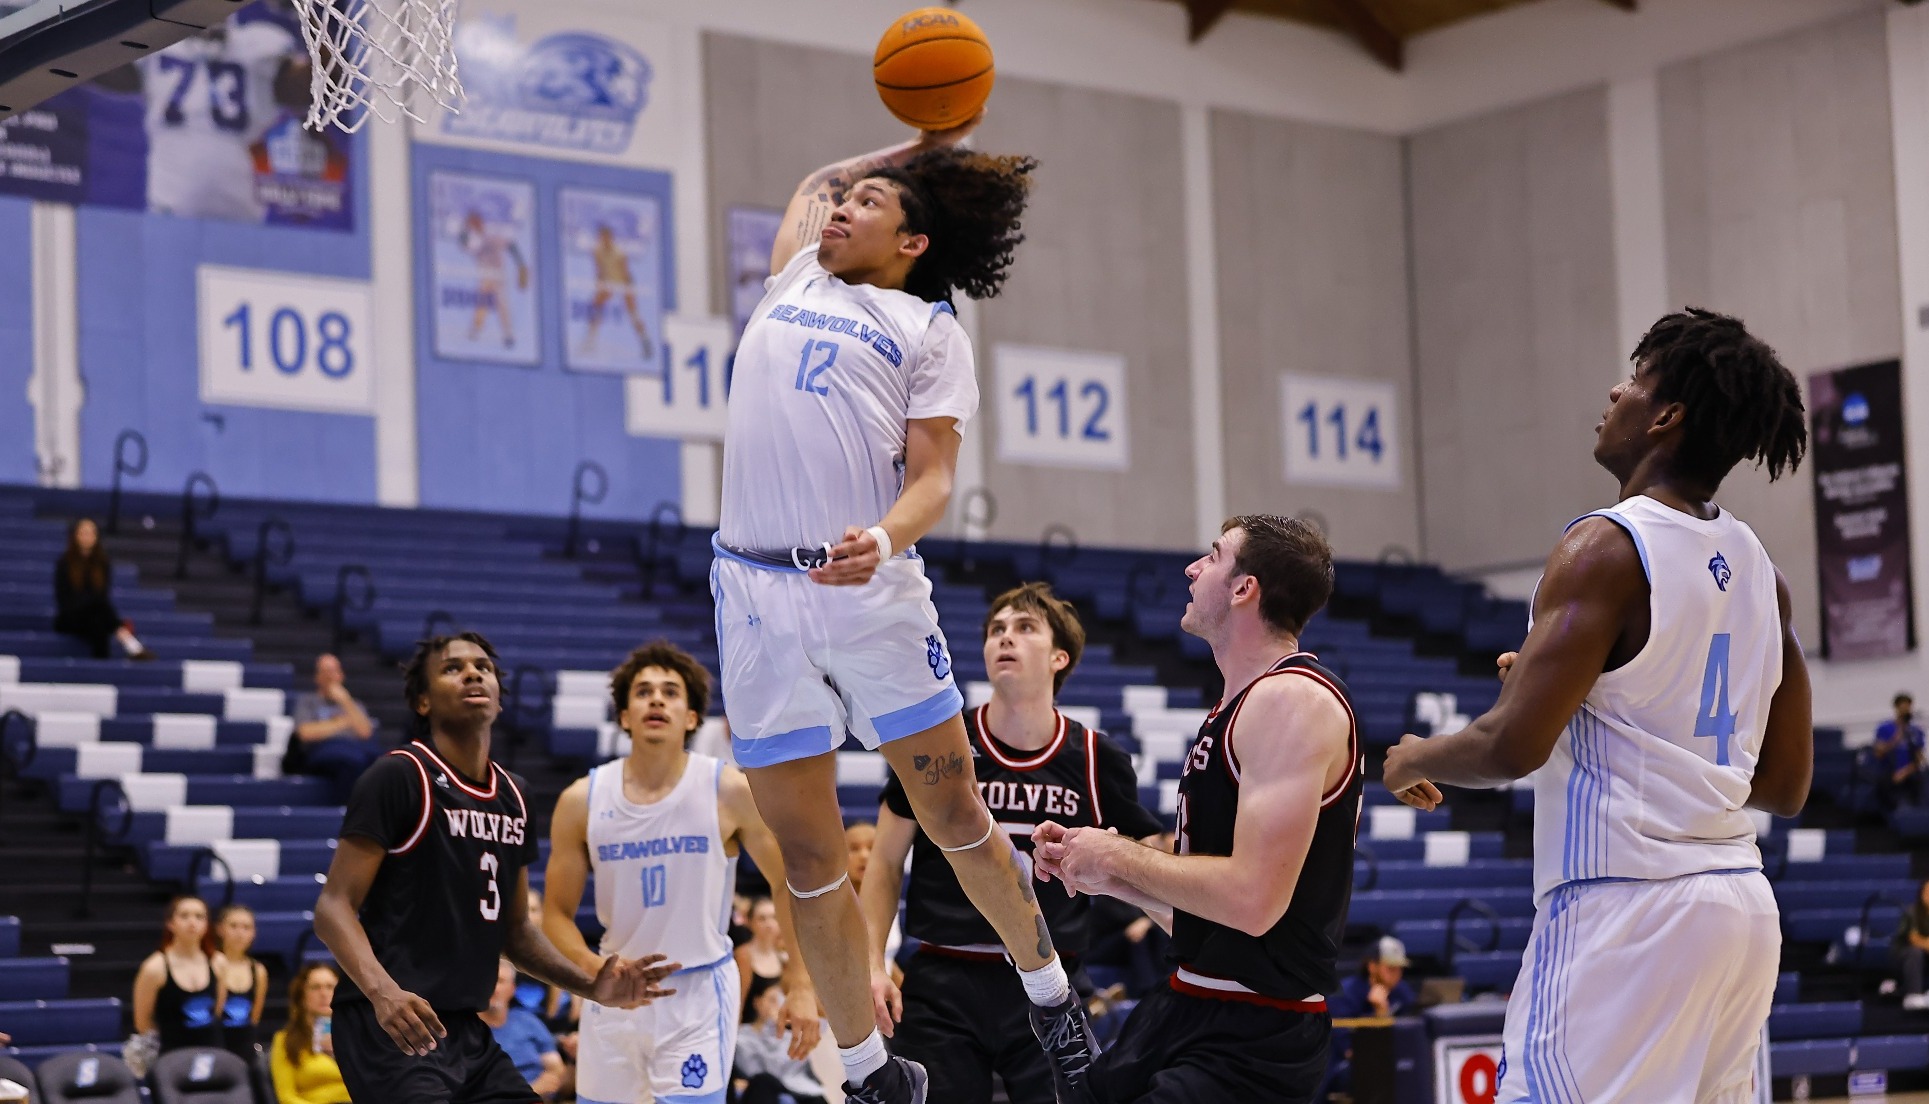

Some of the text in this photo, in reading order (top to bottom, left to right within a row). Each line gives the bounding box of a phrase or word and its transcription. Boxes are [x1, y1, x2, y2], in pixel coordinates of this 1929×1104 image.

[159, 55, 249, 132] 73
[223, 302, 353, 378] 108
[767, 304, 903, 368] SEAWOLVES
[795, 338, 840, 397] 12
[1013, 375, 1110, 441] 112
[1298, 401, 1385, 463] 114
[1693, 632, 1738, 767] 4
[443, 807, 526, 846] WOLVES
[597, 835, 709, 861] SEAWOLVES
[479, 851, 501, 921] 3
[641, 864, 666, 908] 10
